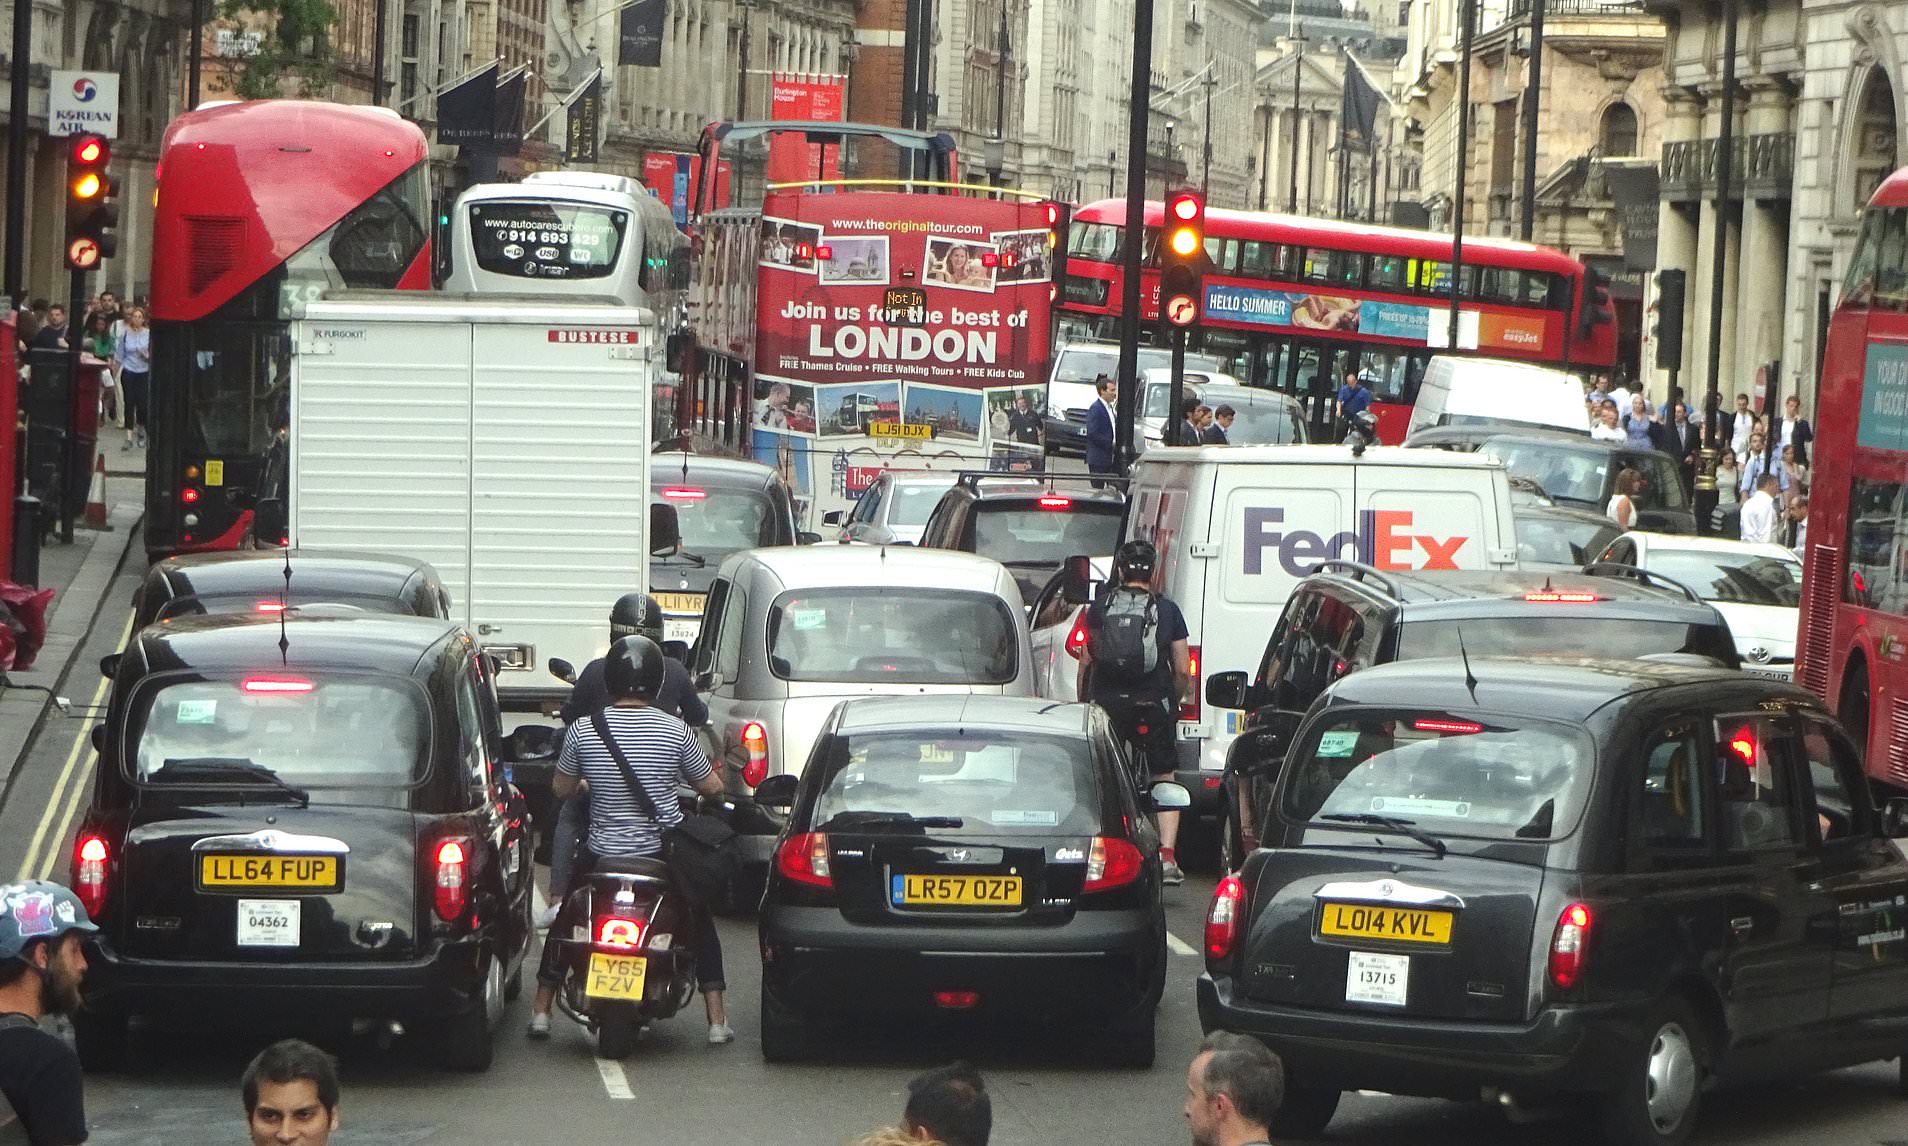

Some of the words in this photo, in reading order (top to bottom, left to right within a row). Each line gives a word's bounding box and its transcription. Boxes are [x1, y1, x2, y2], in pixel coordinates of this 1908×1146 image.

[774, 87, 808, 97] Burlington
[57, 111, 112, 122] KOREAN
[58, 122, 84, 132] AIR
[831, 218, 983, 235] www.theoriginaltour.com
[509, 230, 537, 242] 914
[540, 232, 569, 244] 693
[572, 234, 600, 245] 429
[539, 249, 559, 258] USB
[887, 291, 909, 305] Not
[911, 292, 923, 306] In
[1209, 293, 1240, 311] HELLO
[1242, 297, 1286, 316] SUMMER
[780, 301, 827, 320] Join
[834, 306, 861, 321] us
[951, 307, 1000, 326] best
[1006, 310, 1028, 328] of
[558, 331, 629, 344] BUSTESE
[809, 324, 997, 364] LONDON
[1503, 331, 1538, 343] easyJet
[779, 359, 799, 369] FREE
[801, 361, 834, 371] Thames
[836, 363, 863, 373] Cruise
[872, 364, 893, 373] FREE
[895, 364, 929, 376] Walking
[931, 367, 954, 376] Tours
[964, 367, 985, 377] FREE
[987, 369, 1006, 378] Kids
[876, 424, 900, 435] LJ51
[903, 426, 924, 437] DJX
[852, 468, 873, 485] The
[1242, 506, 1468, 578] FedEx
[684, 595, 705, 610] YR
[1055, 848, 1083, 860] Getz
[213, 859, 273, 881] LL64
[281, 860, 326, 881] FUP
[907, 879, 967, 899] LR57
[973, 880, 1018, 900] OZP
[249, 916, 289, 928] 04362
[1335, 908, 1385, 933] LO14
[1391, 911, 1435, 937] KVL
[592, 957, 643, 977] LY65
[596, 975, 634, 993] FZV
[1360, 971, 1396, 985] 13715
